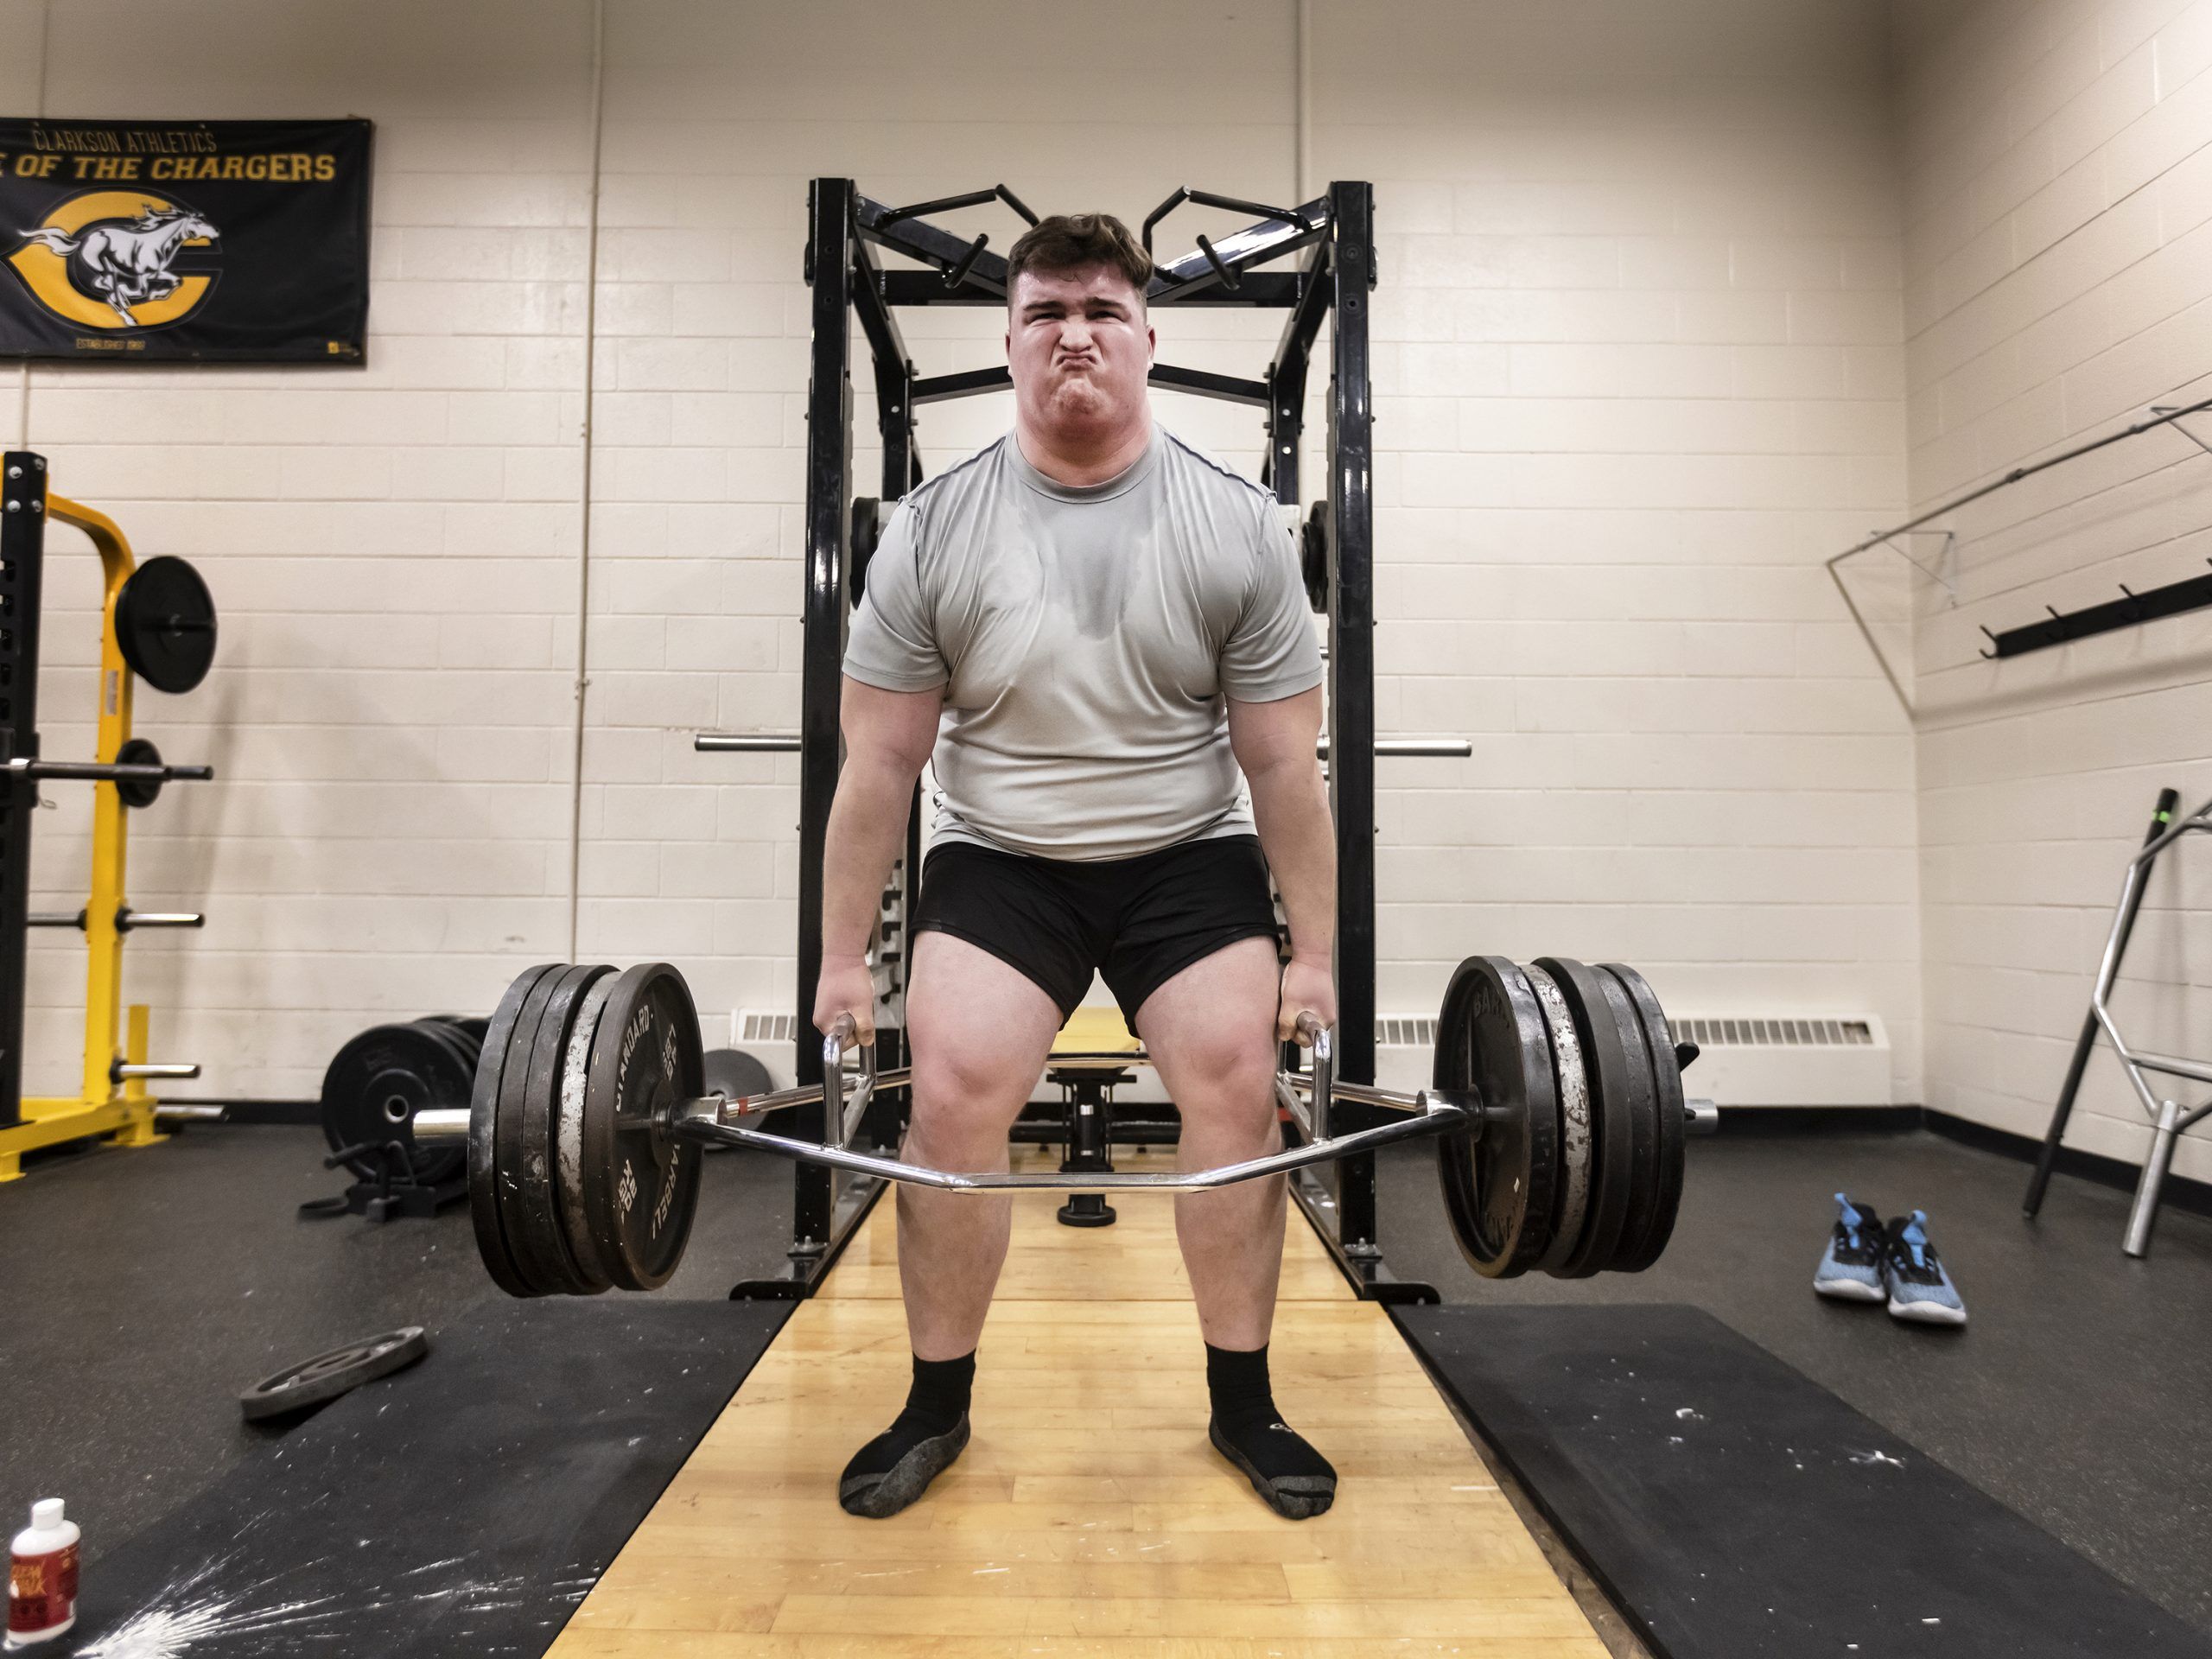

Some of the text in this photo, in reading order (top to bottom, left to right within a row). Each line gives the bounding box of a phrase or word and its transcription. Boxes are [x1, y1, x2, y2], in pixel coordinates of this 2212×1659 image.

[34, 130, 217, 153] CLARKSON ATHLETICS
[16, 154, 62, 178] OF
[73, 156, 142, 180] THE
[151, 154, 336, 181] CHARGERS
